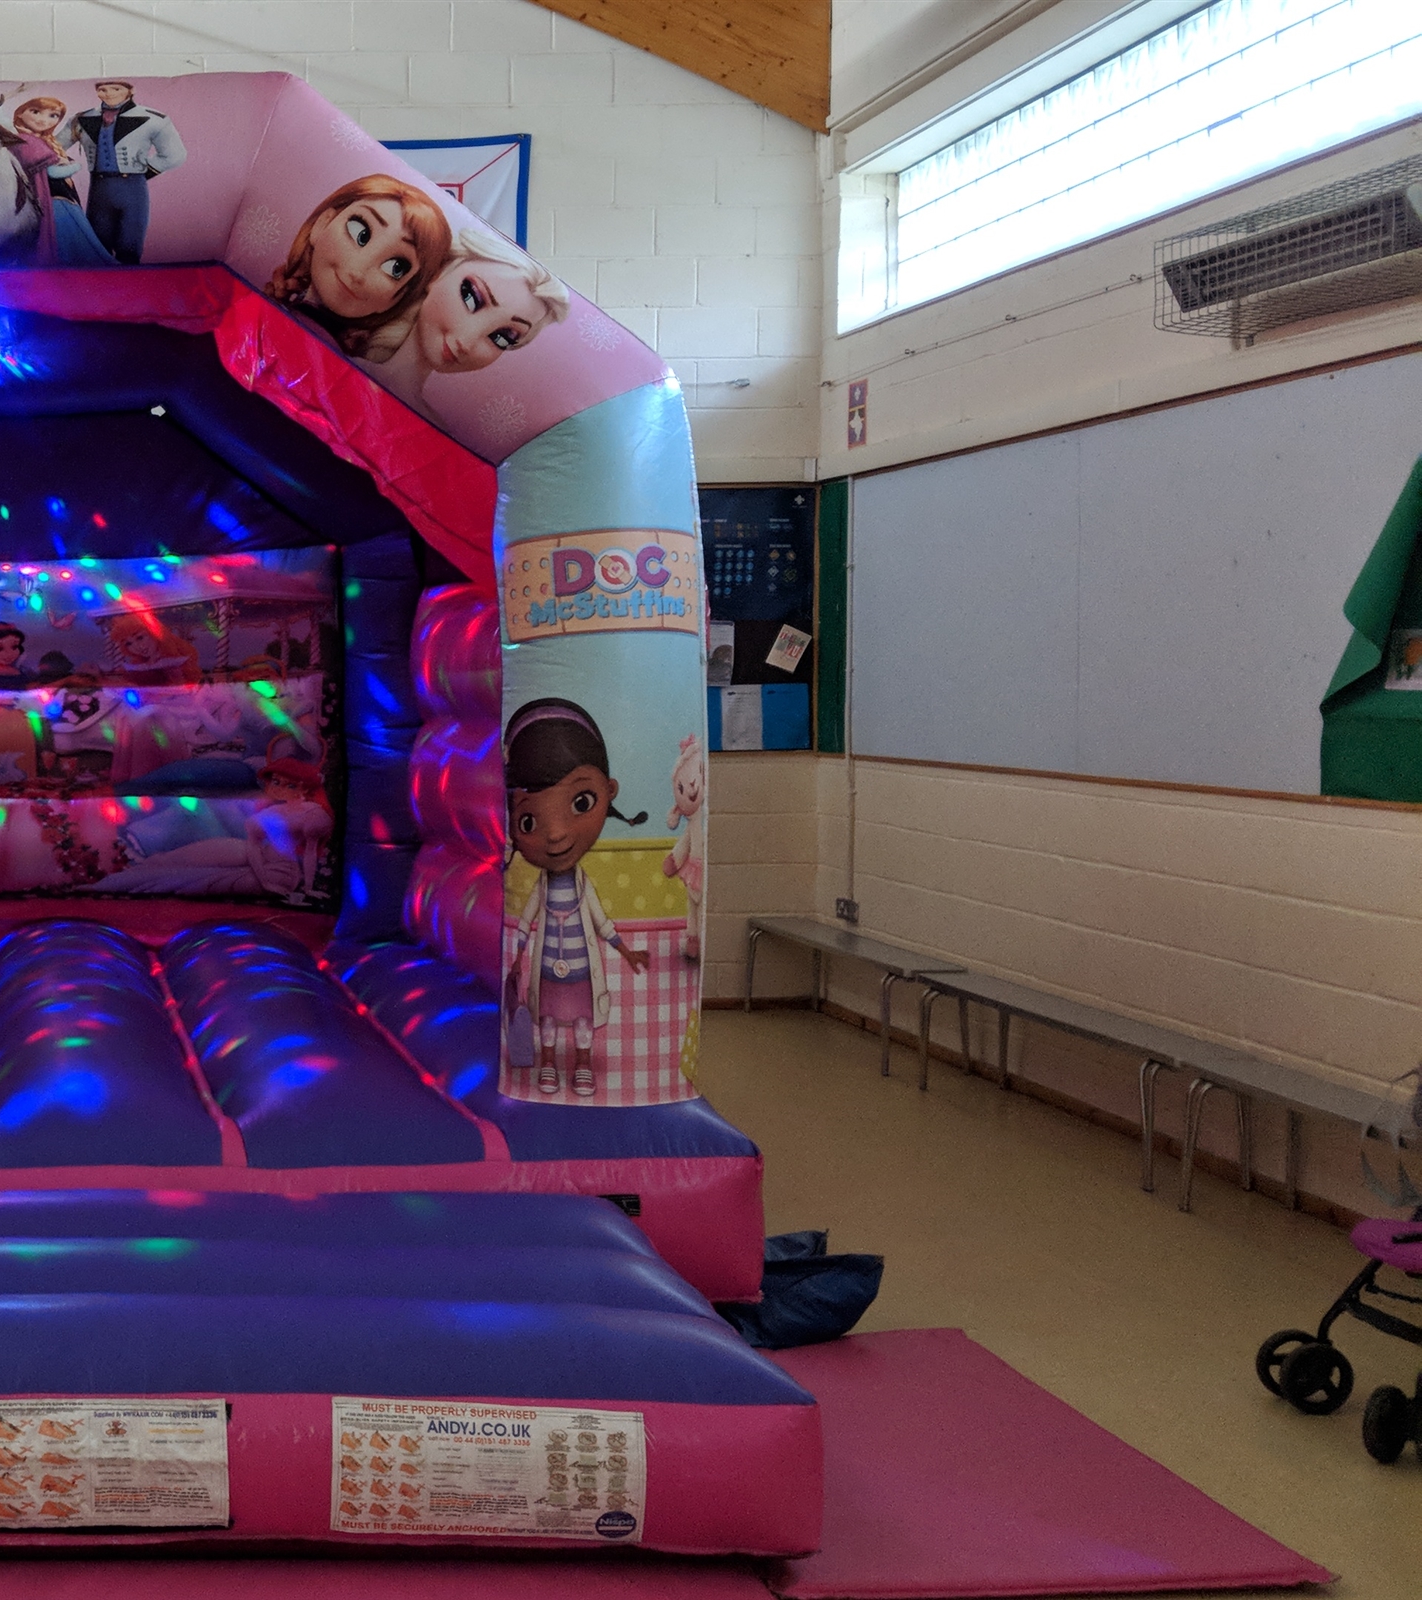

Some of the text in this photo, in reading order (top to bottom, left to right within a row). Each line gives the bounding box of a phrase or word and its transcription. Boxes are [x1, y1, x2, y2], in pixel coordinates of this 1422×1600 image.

[552, 543, 671, 598] DOC
[530, 589, 686, 627] McStuffins
[362, 1403, 391, 1413] MUST
[394, 1404, 409, 1414] BE
[411, 1405, 467, 1417] PROPERLY
[470, 1407, 537, 1420] SUPERVISED
[427, 1420, 531, 1438] ANDYJ.CO.UK
[341, 1520, 370, 1529] MUST
[373, 1522, 388, 1530] BE
[390, 1523, 446, 1532] SECURELY
[446, 1525, 507, 1533] ANCHORED
